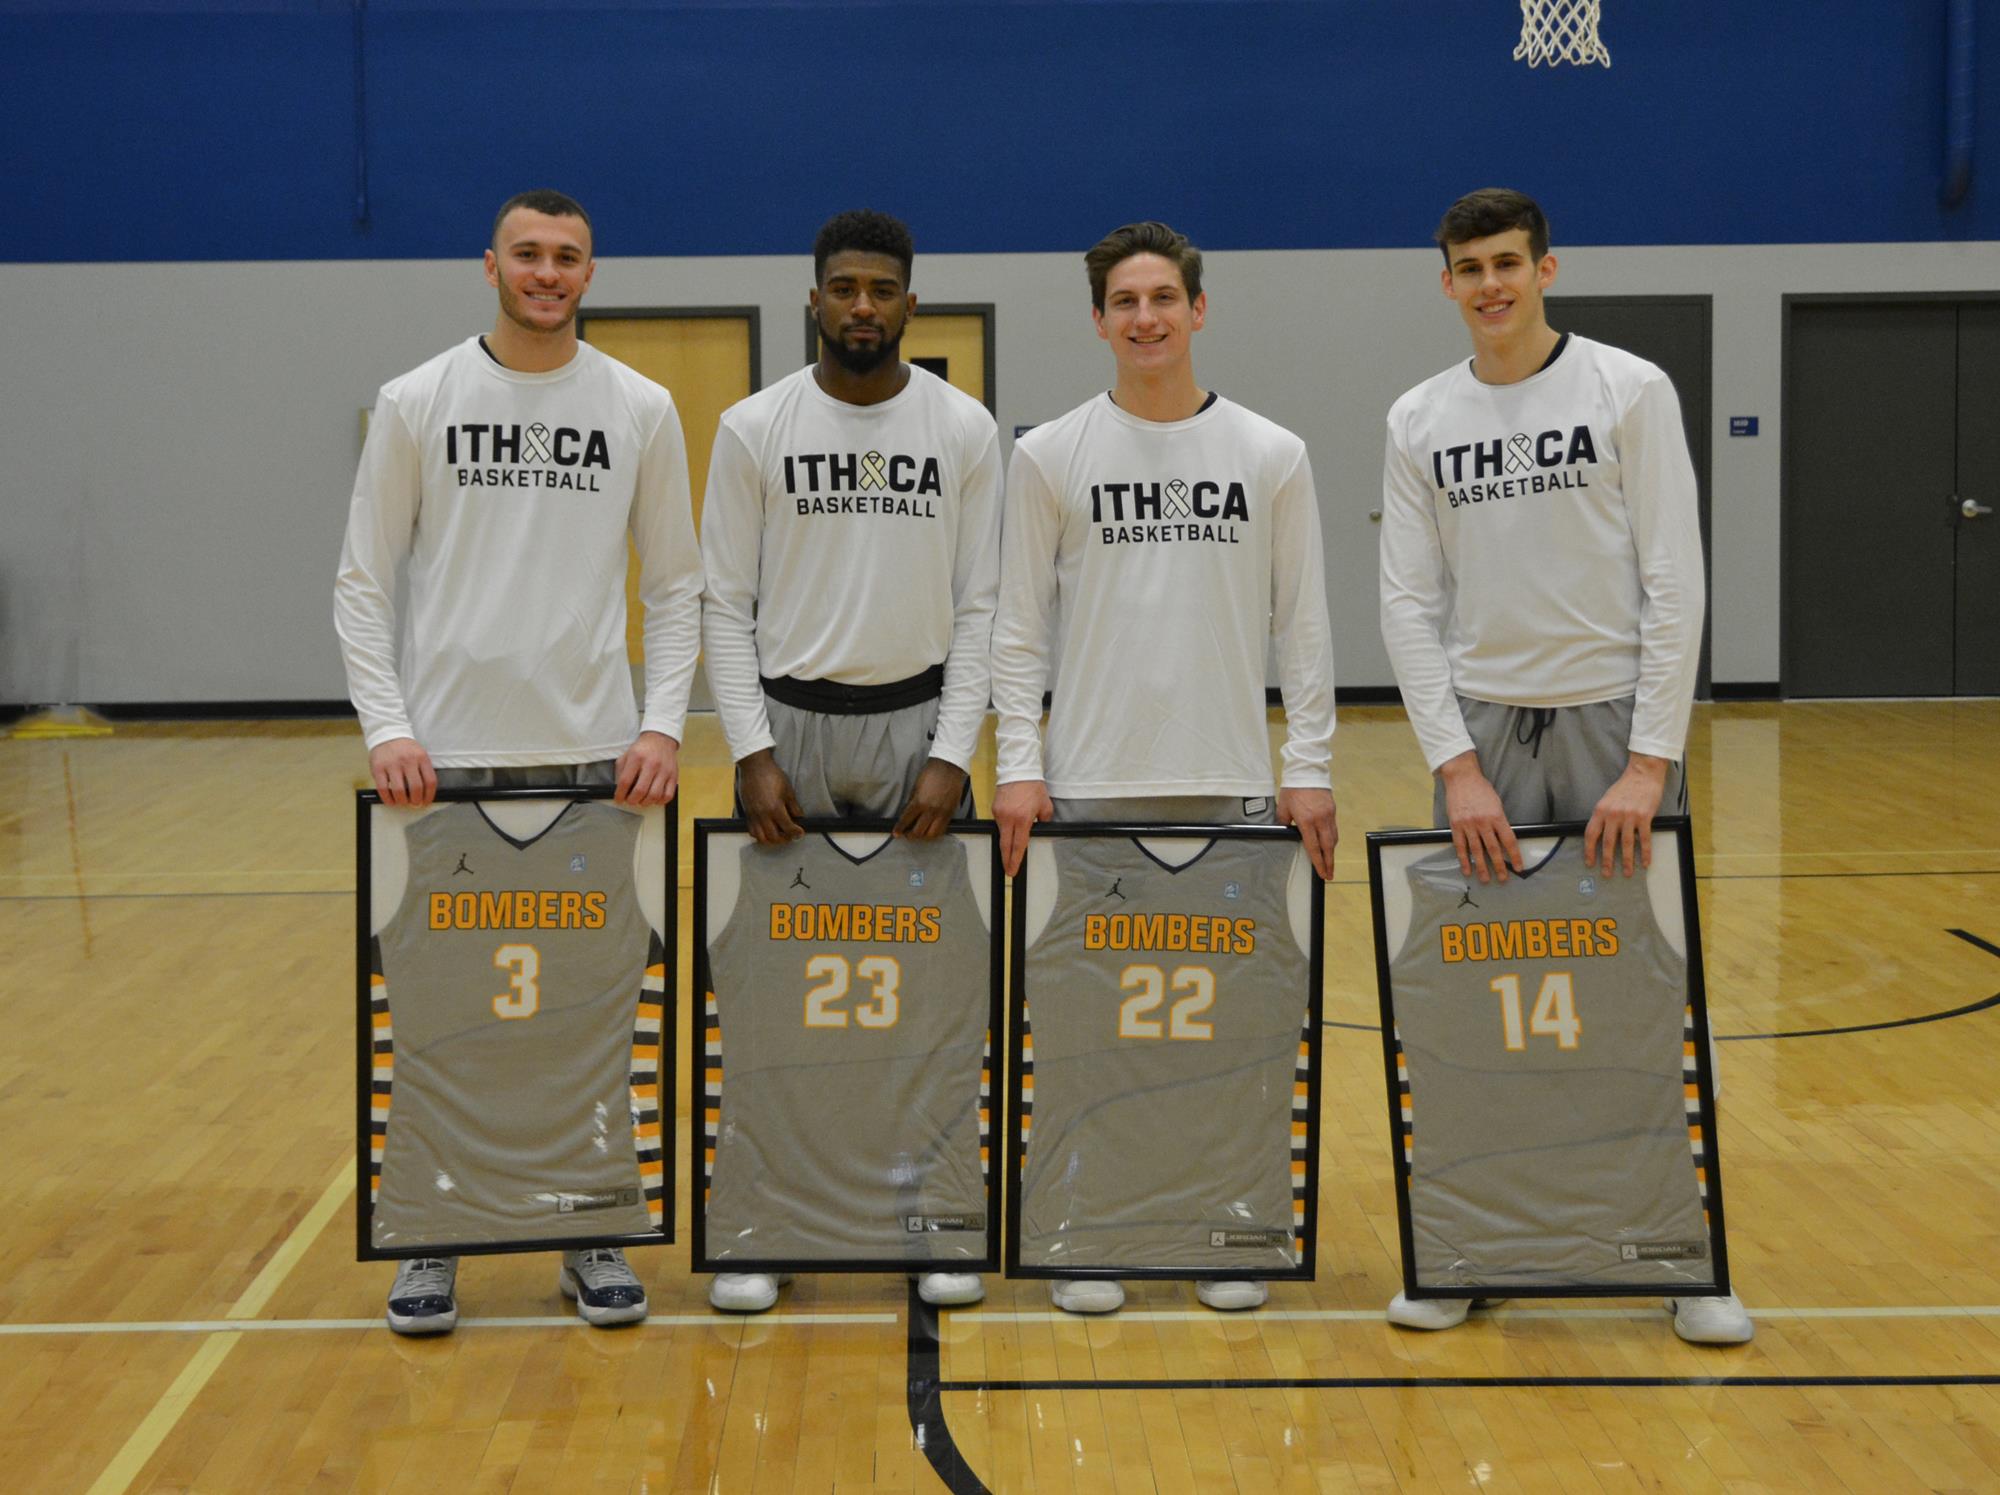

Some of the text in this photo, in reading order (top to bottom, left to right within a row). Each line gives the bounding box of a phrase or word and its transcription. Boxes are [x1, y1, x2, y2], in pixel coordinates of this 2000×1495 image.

[457, 468, 600, 493] BASKETBALL
[1447, 469, 1589, 509] BASKETBALL
[796, 496, 936, 519] BASKETBALL
[1101, 523, 1240, 545] BASKETBALL
[428, 891, 607, 931] BOMBERS
[769, 902, 941, 943] BOMBERS
[1084, 913, 1255, 955] BOMBERS
[1440, 917, 1619, 963] BOMBERS
[491, 943, 541, 1020] 3
[804, 954, 902, 1029] 23
[1117, 963, 1216, 1040] 22
[1489, 972, 1583, 1052] 14
